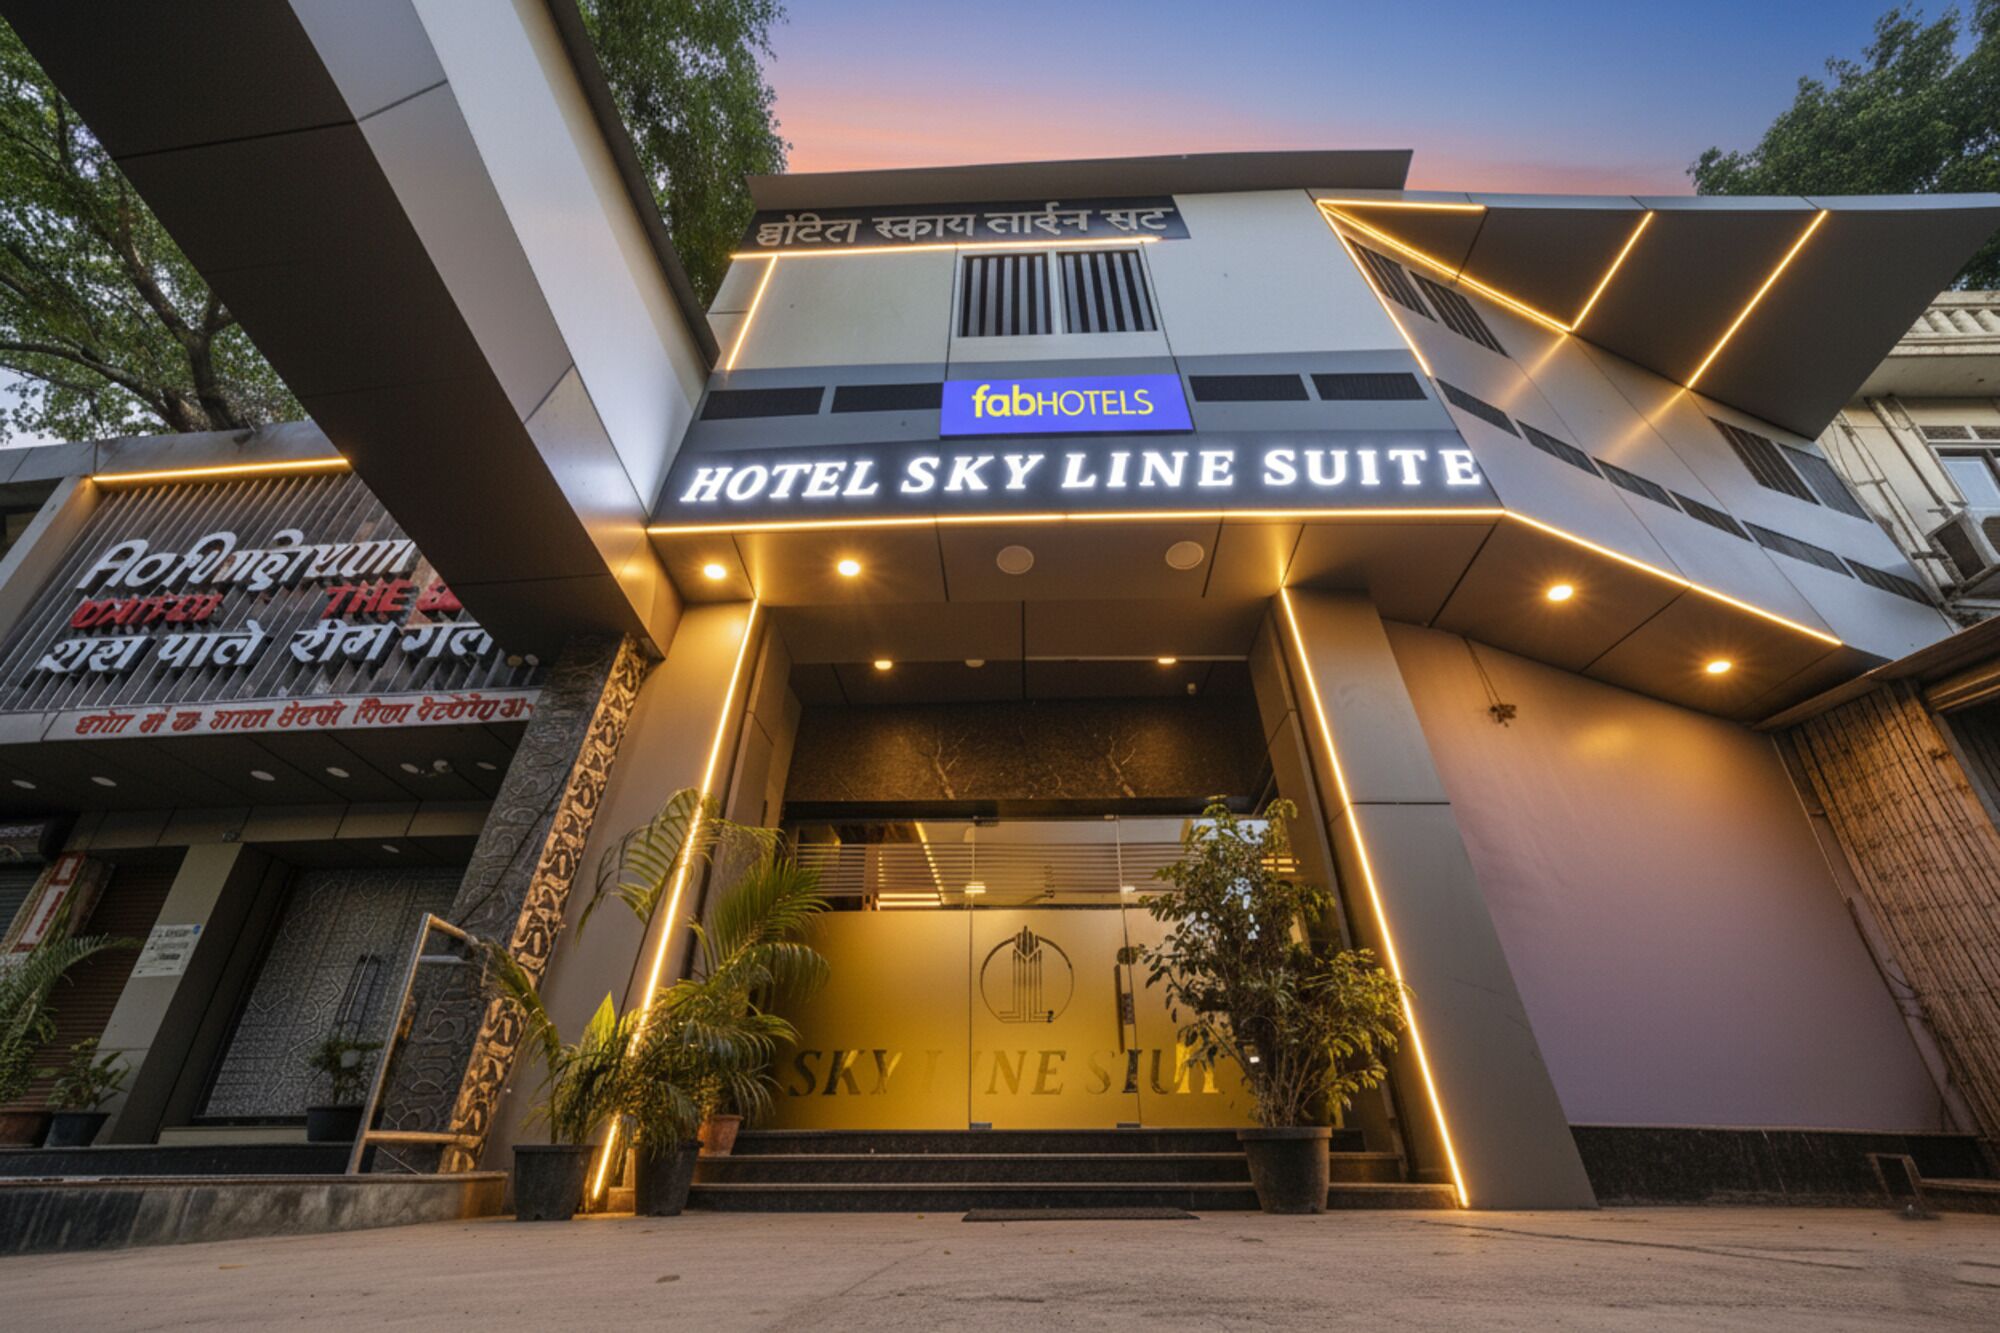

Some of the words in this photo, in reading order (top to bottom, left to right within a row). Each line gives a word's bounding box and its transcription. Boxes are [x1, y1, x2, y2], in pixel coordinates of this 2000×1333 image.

[971, 384, 1154, 418] fabHOTELS
[679, 460, 880, 502] HOTEL
[900, 453, 1045, 493] SKY
[1061, 450, 1235, 489] LINE
[1263, 449, 1481, 487] SUITE
[787, 1049, 904, 1097] SKY
